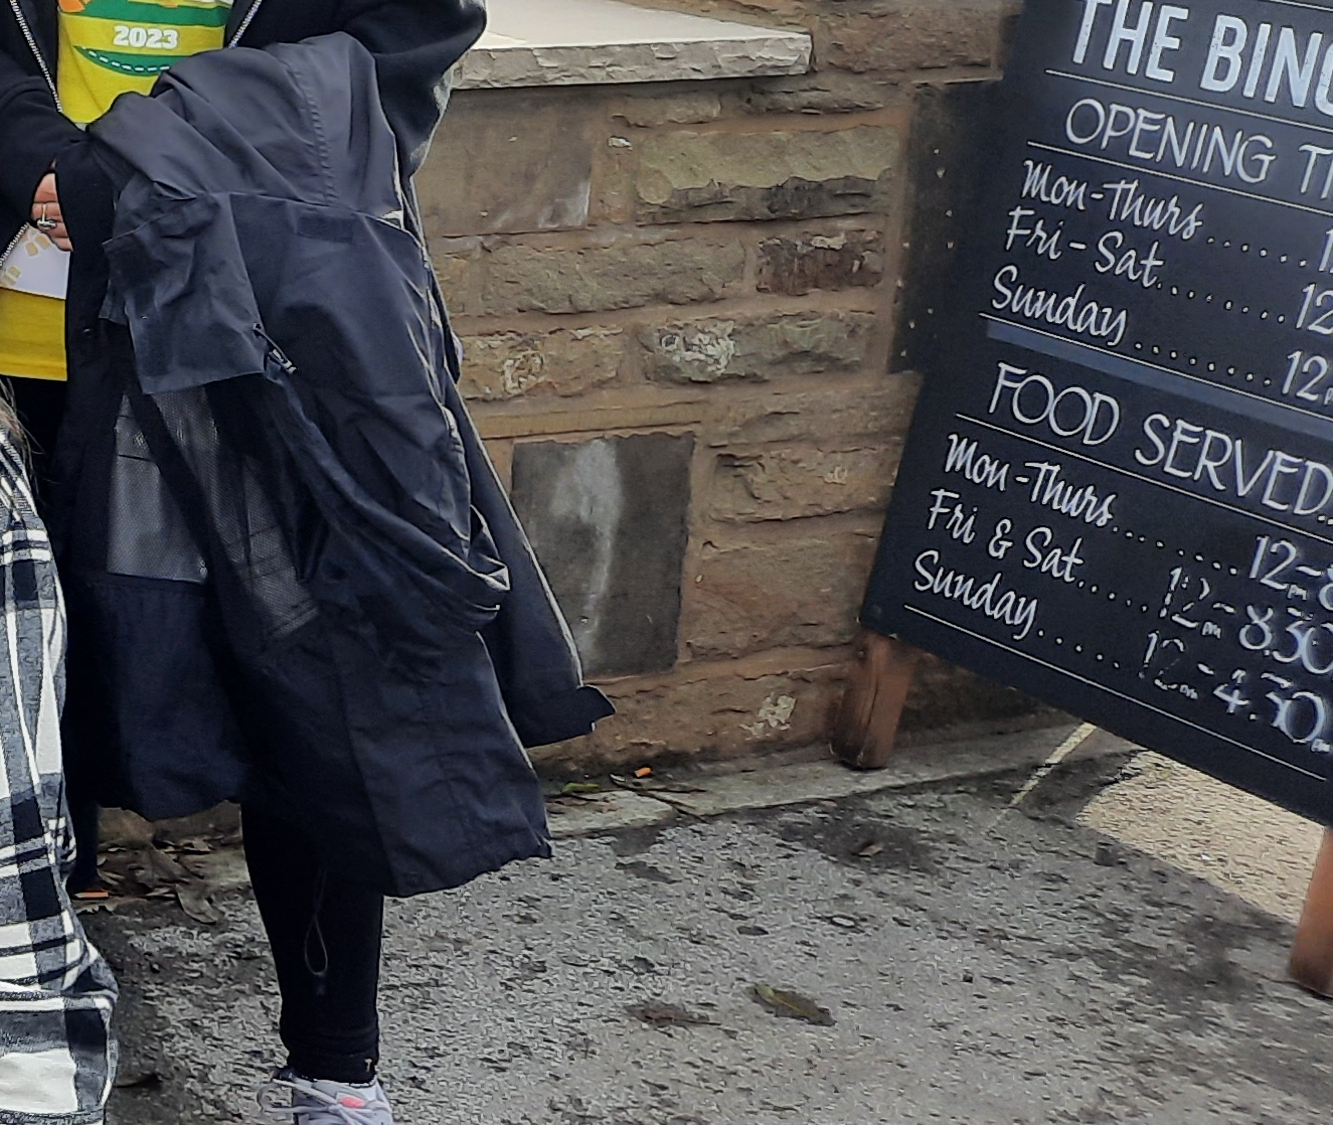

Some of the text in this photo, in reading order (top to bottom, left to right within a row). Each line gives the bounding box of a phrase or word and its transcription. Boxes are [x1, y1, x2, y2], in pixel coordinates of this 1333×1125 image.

[112, 25, 179, 49] 2023
[1065, 98, 1277, 184] OPENING
[991, 264, 1130, 346] Sunday
[988, 361, 1121, 446] FOOD
[927, 488, 1085, 585] Fri & Sat
[913, 550, 1040, 640] Sunday
